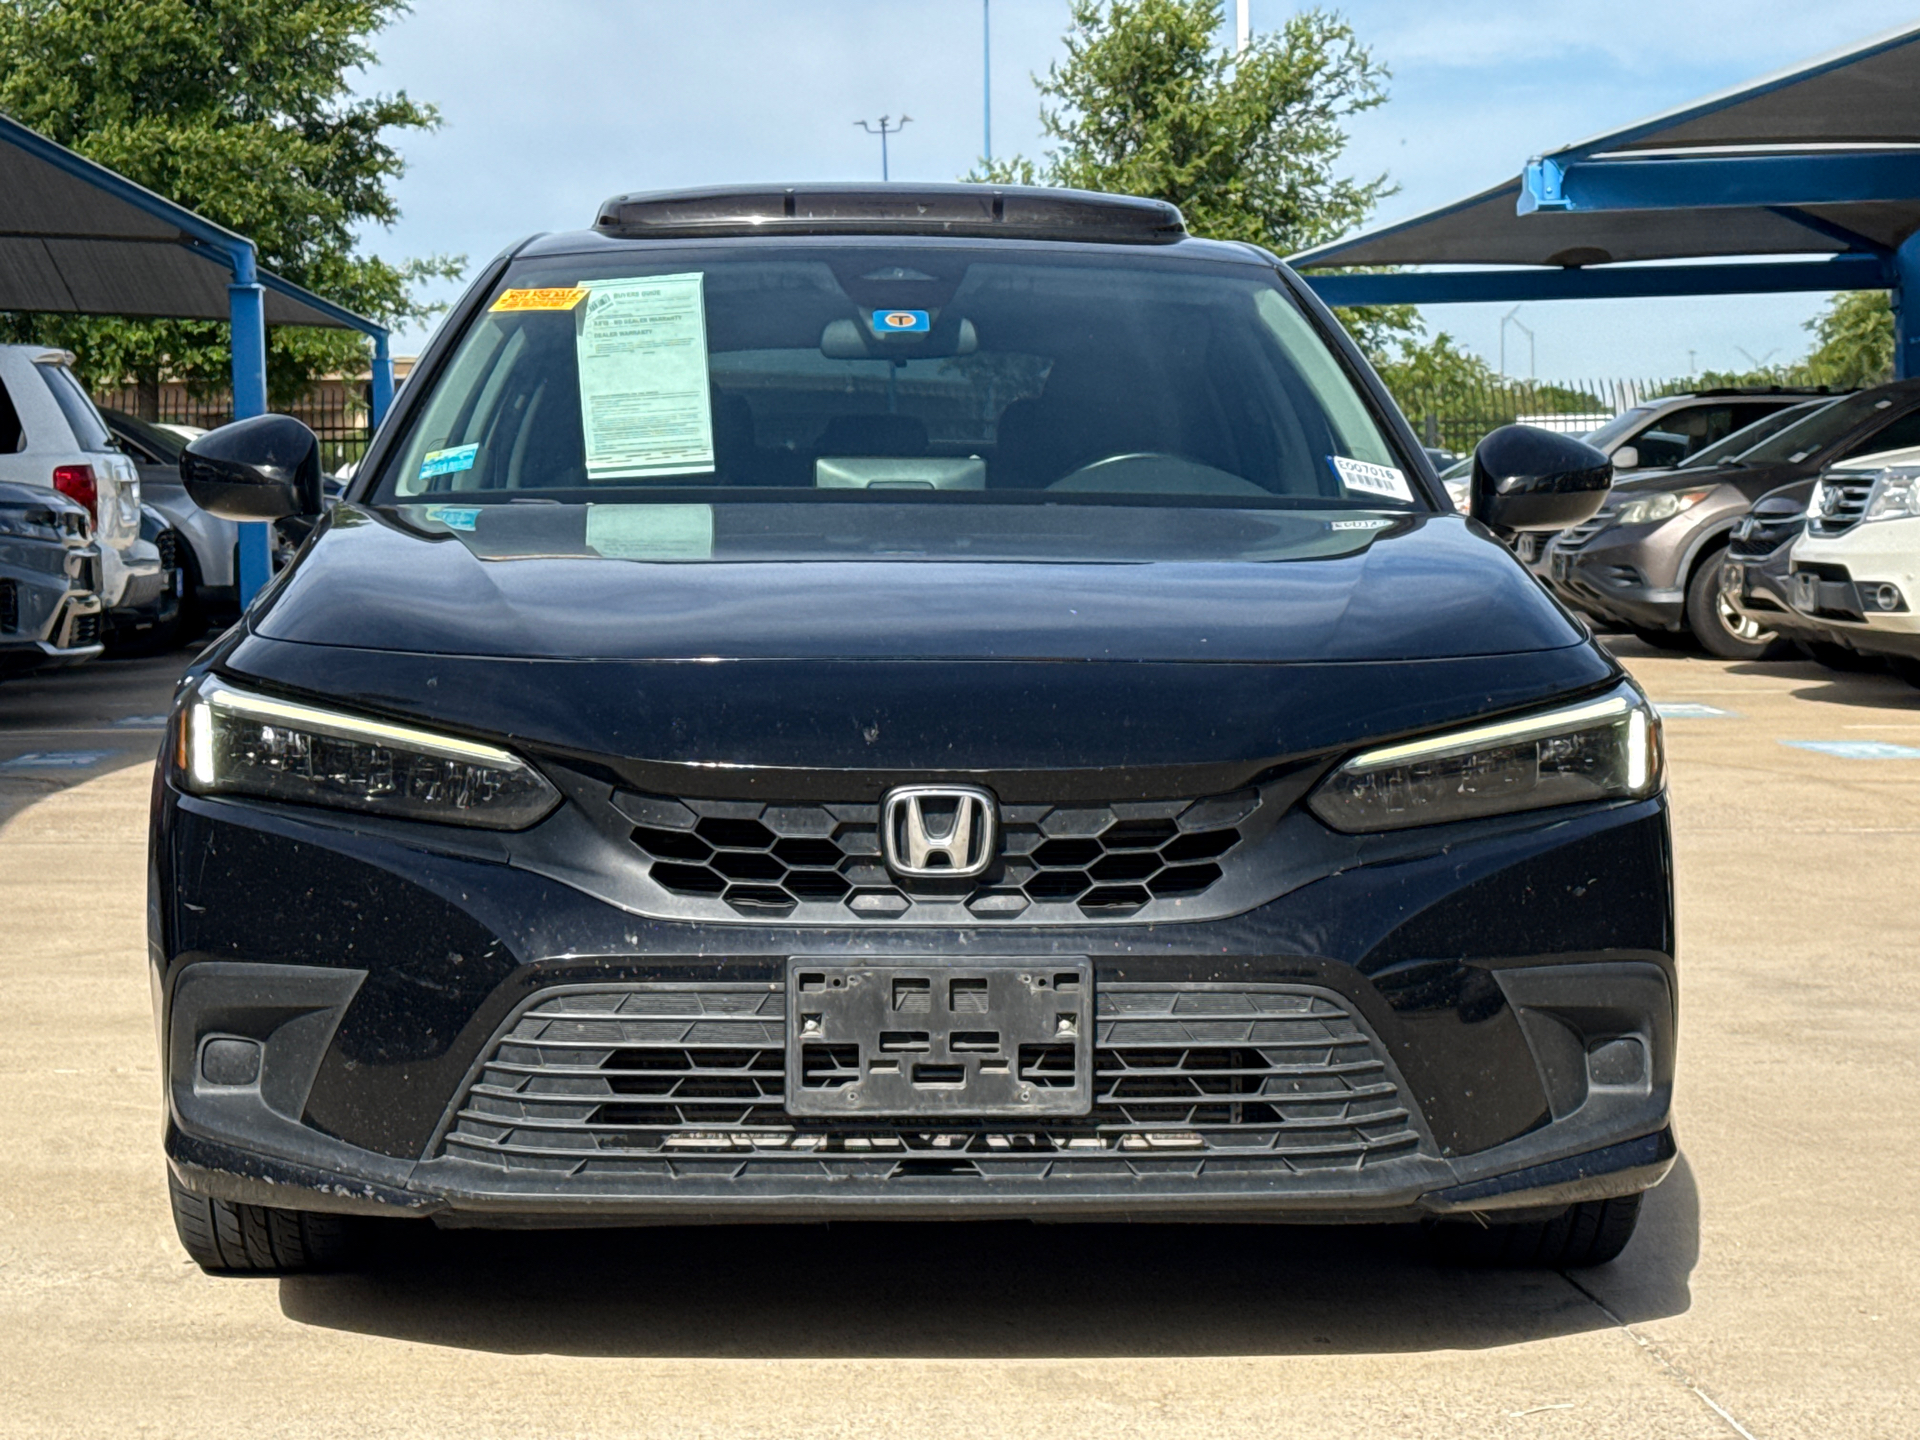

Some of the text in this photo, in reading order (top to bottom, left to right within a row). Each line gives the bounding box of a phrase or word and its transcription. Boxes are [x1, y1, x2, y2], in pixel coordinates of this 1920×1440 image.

[613, 289, 661, 299] BUYERS GUIDE
[648, 315, 682, 323] WARRANTY
[594, 329, 653, 339] DEALER WARRANTY
